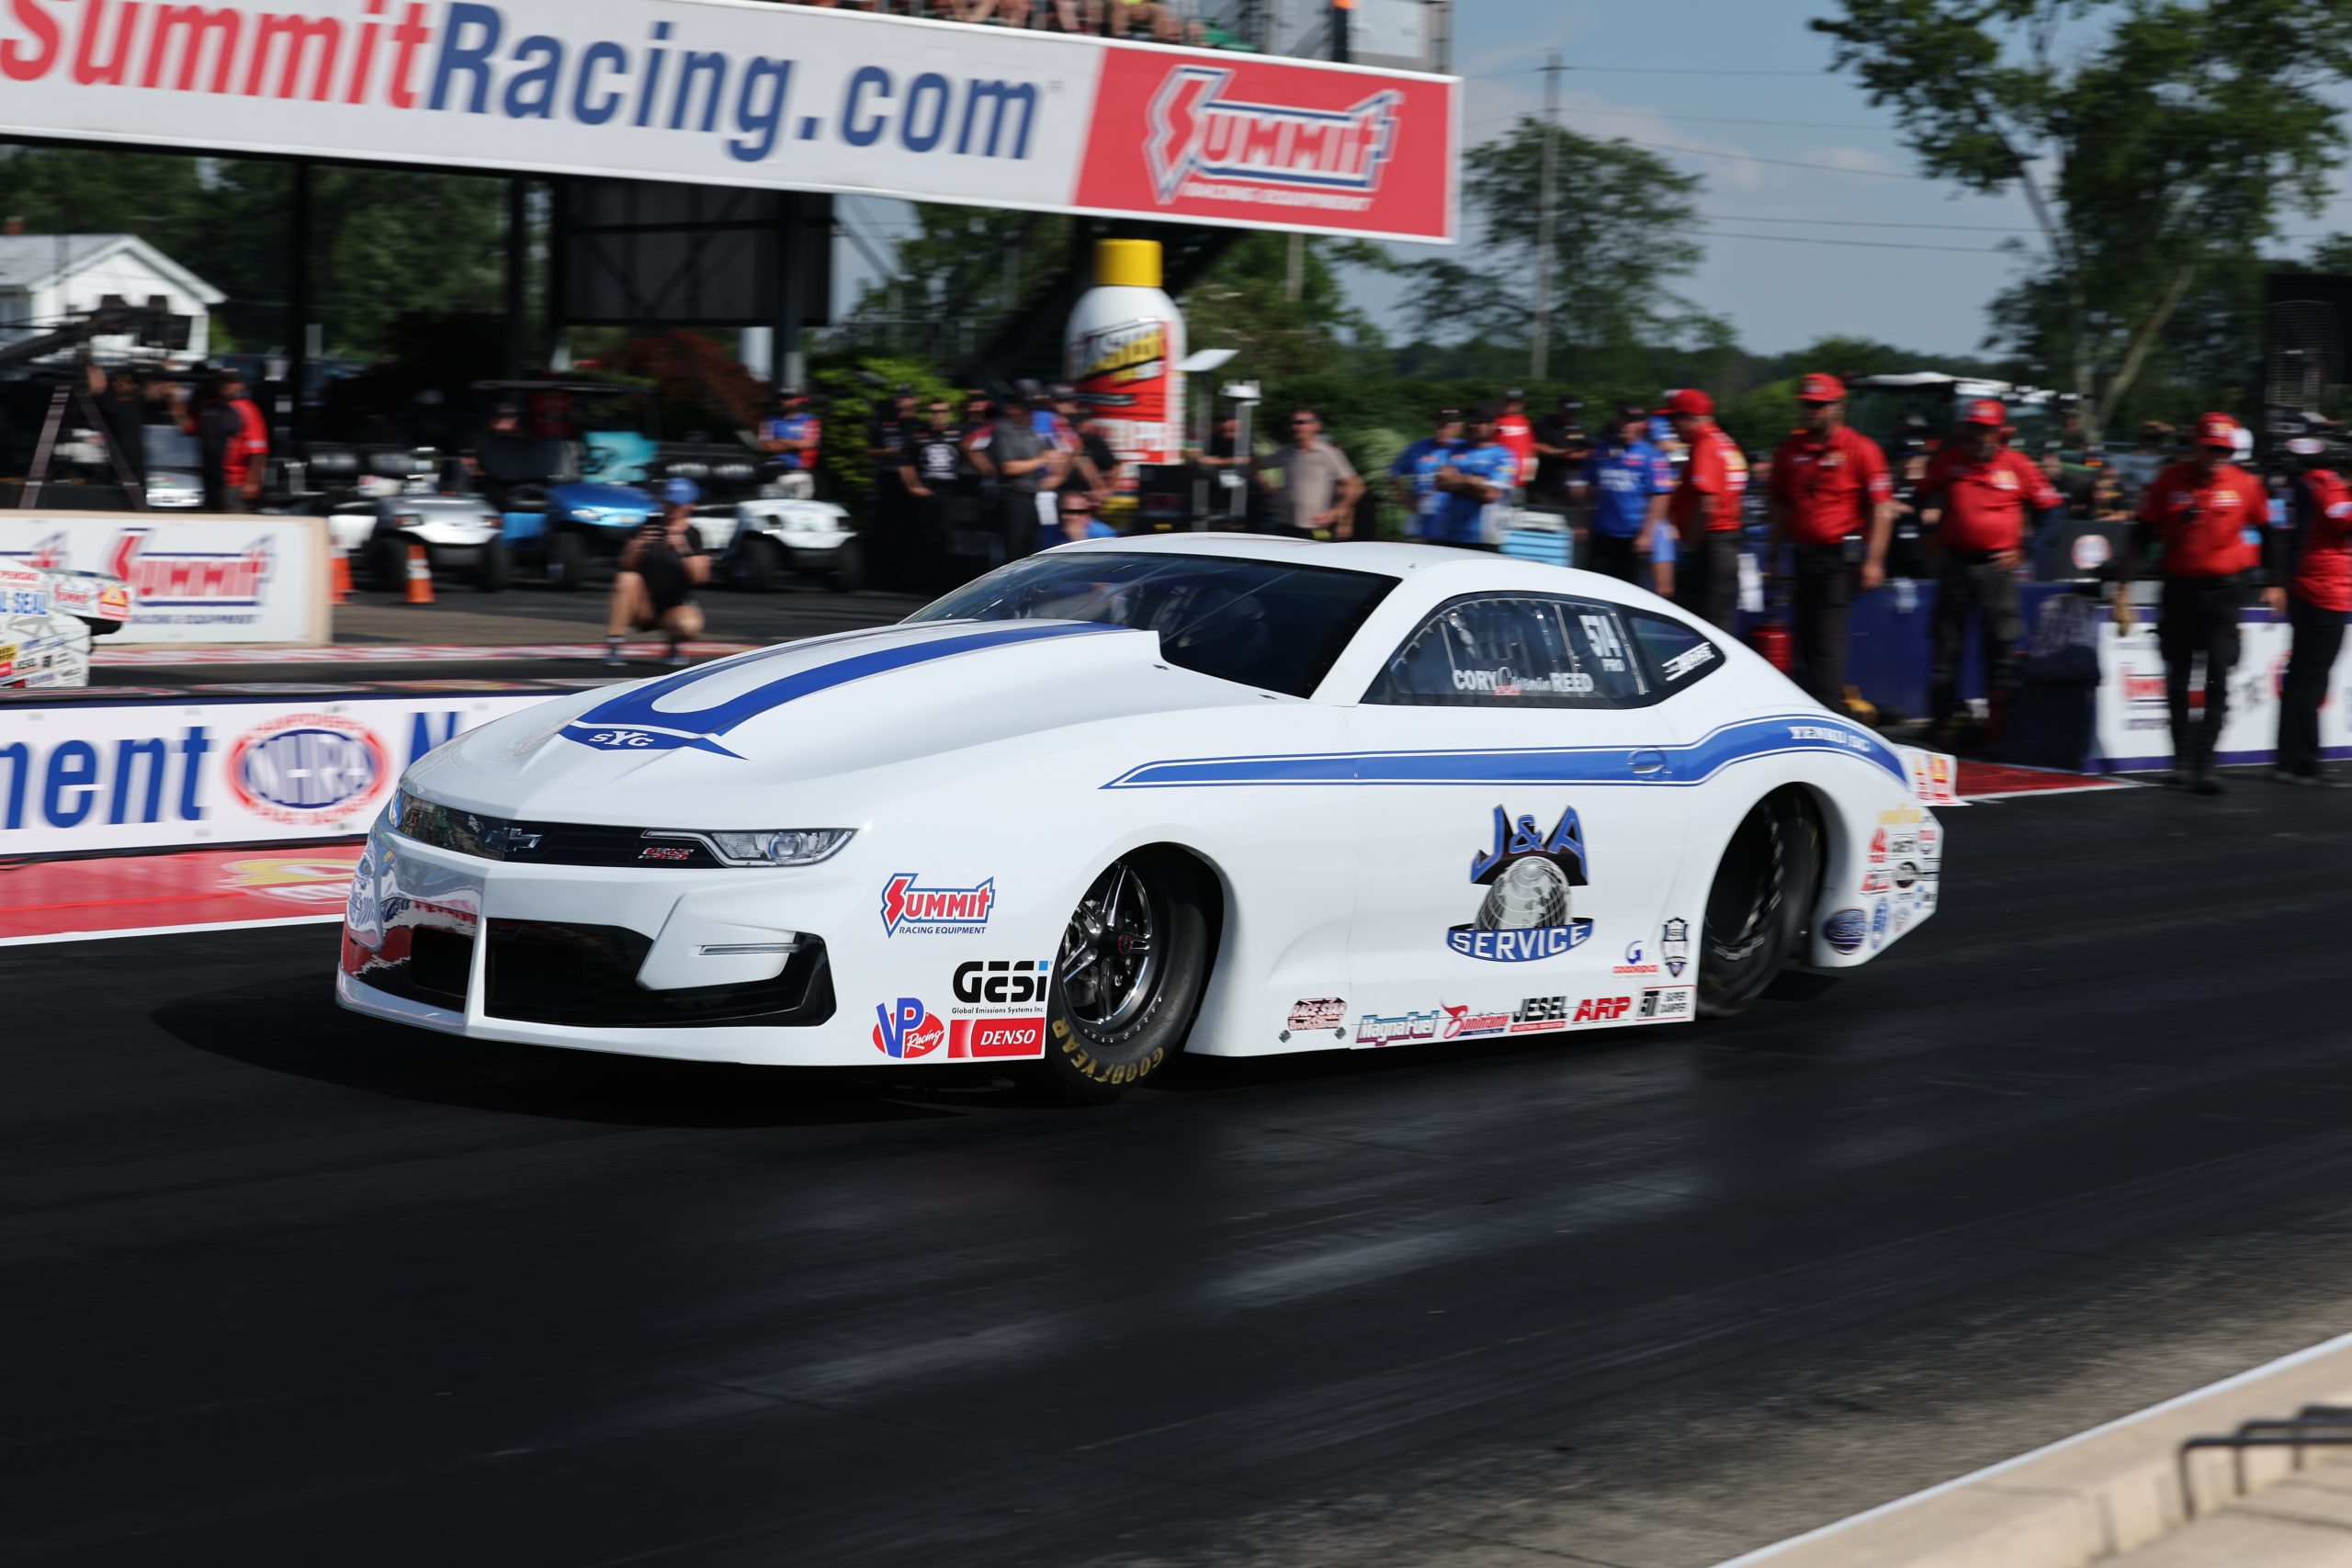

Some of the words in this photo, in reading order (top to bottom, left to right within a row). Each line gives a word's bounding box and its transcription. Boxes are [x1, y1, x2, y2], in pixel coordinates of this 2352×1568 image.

[1453, 669, 1498, 691] CORY
[1550, 672, 1594, 692] REED
[1470, 804, 1589, 886] J&A
[899, 926, 933, 934] RACING
[935, 926, 987, 934] EQUIPMENT
[1452, 924, 1589, 960] SERVICE
[1008, 1006, 1033, 1014] Systems
[1513, 996, 1567, 1022] JESEL
[1573, 996, 1632, 1022] ARP
[876, 998, 924, 1058] VP
[906, 1029, 945, 1053] Racing
[980, 1029, 1036, 1045] DENSO
[1052, 1016, 1164, 1085] GOODYEAR
